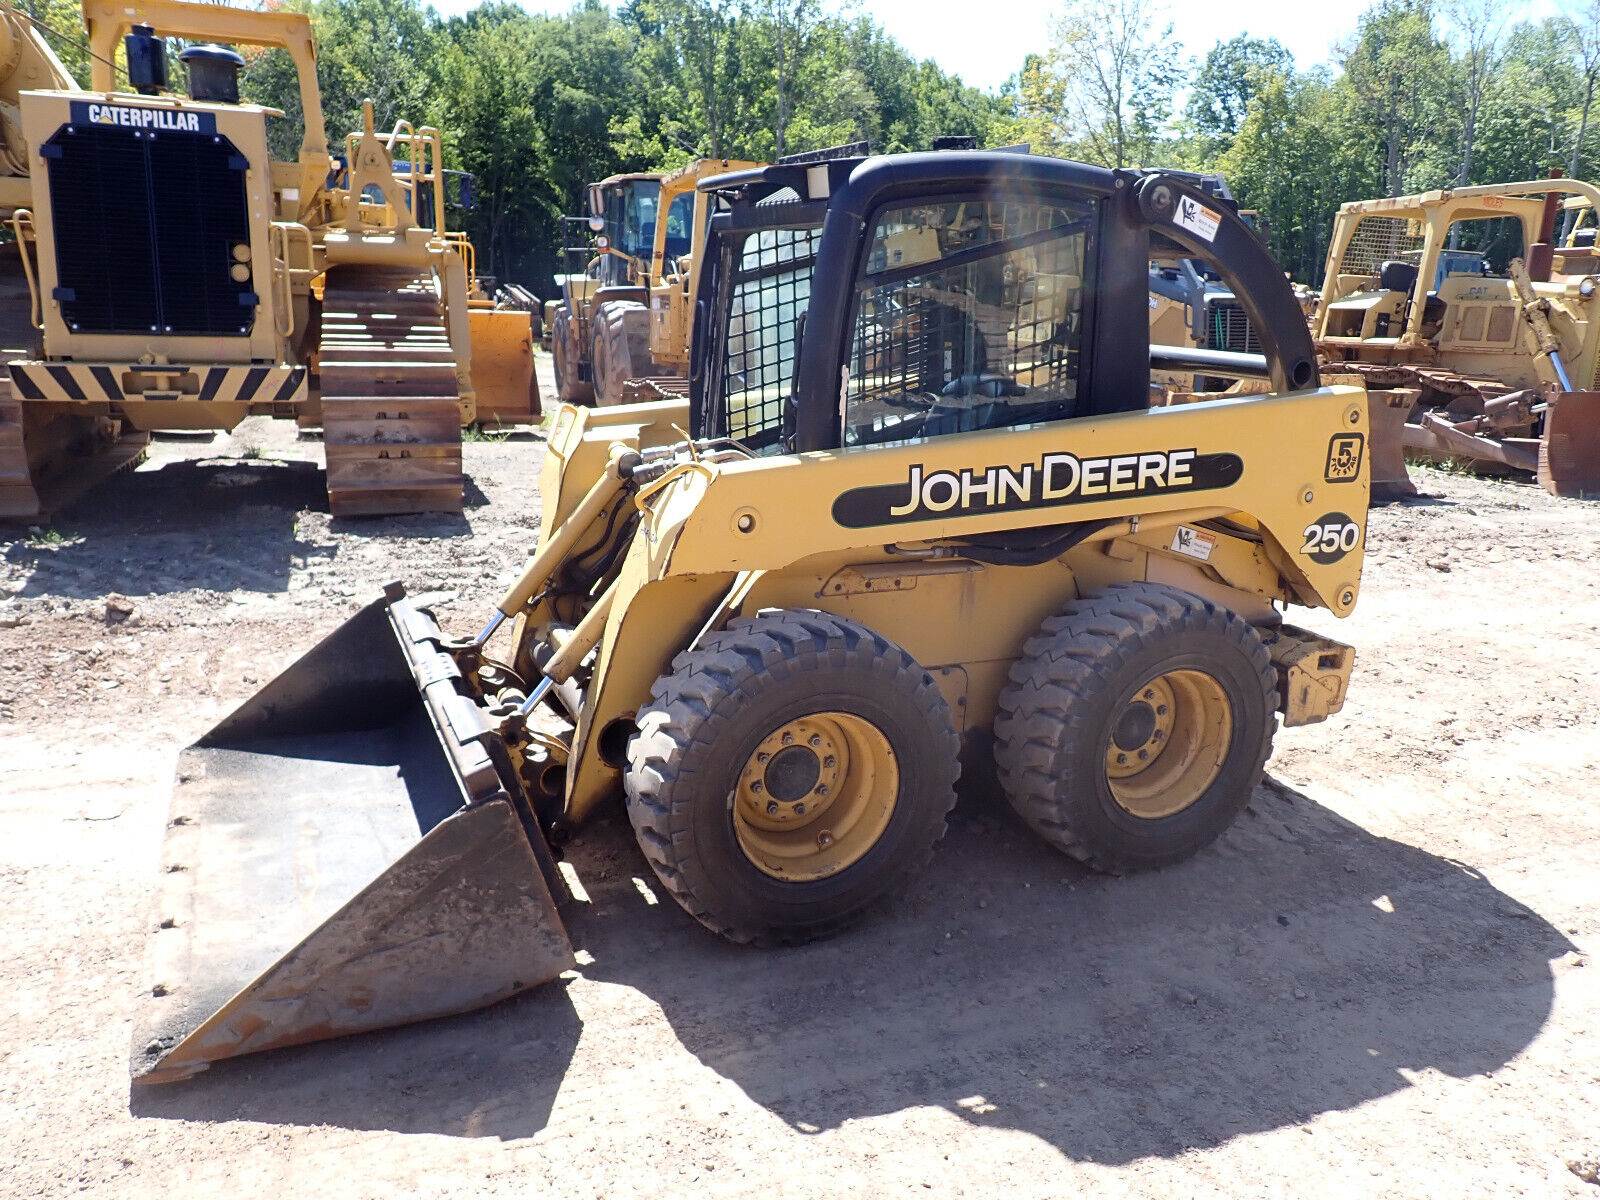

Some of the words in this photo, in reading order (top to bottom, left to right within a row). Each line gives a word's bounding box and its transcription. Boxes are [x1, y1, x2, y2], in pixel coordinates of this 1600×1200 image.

[88, 104, 200, 131] CATERPILLAR
[1338, 441, 1352, 468] 5
[890, 466, 1032, 516] JOHN
[1042, 450, 1196, 500] DEERE
[1300, 522, 1360, 554] 250
